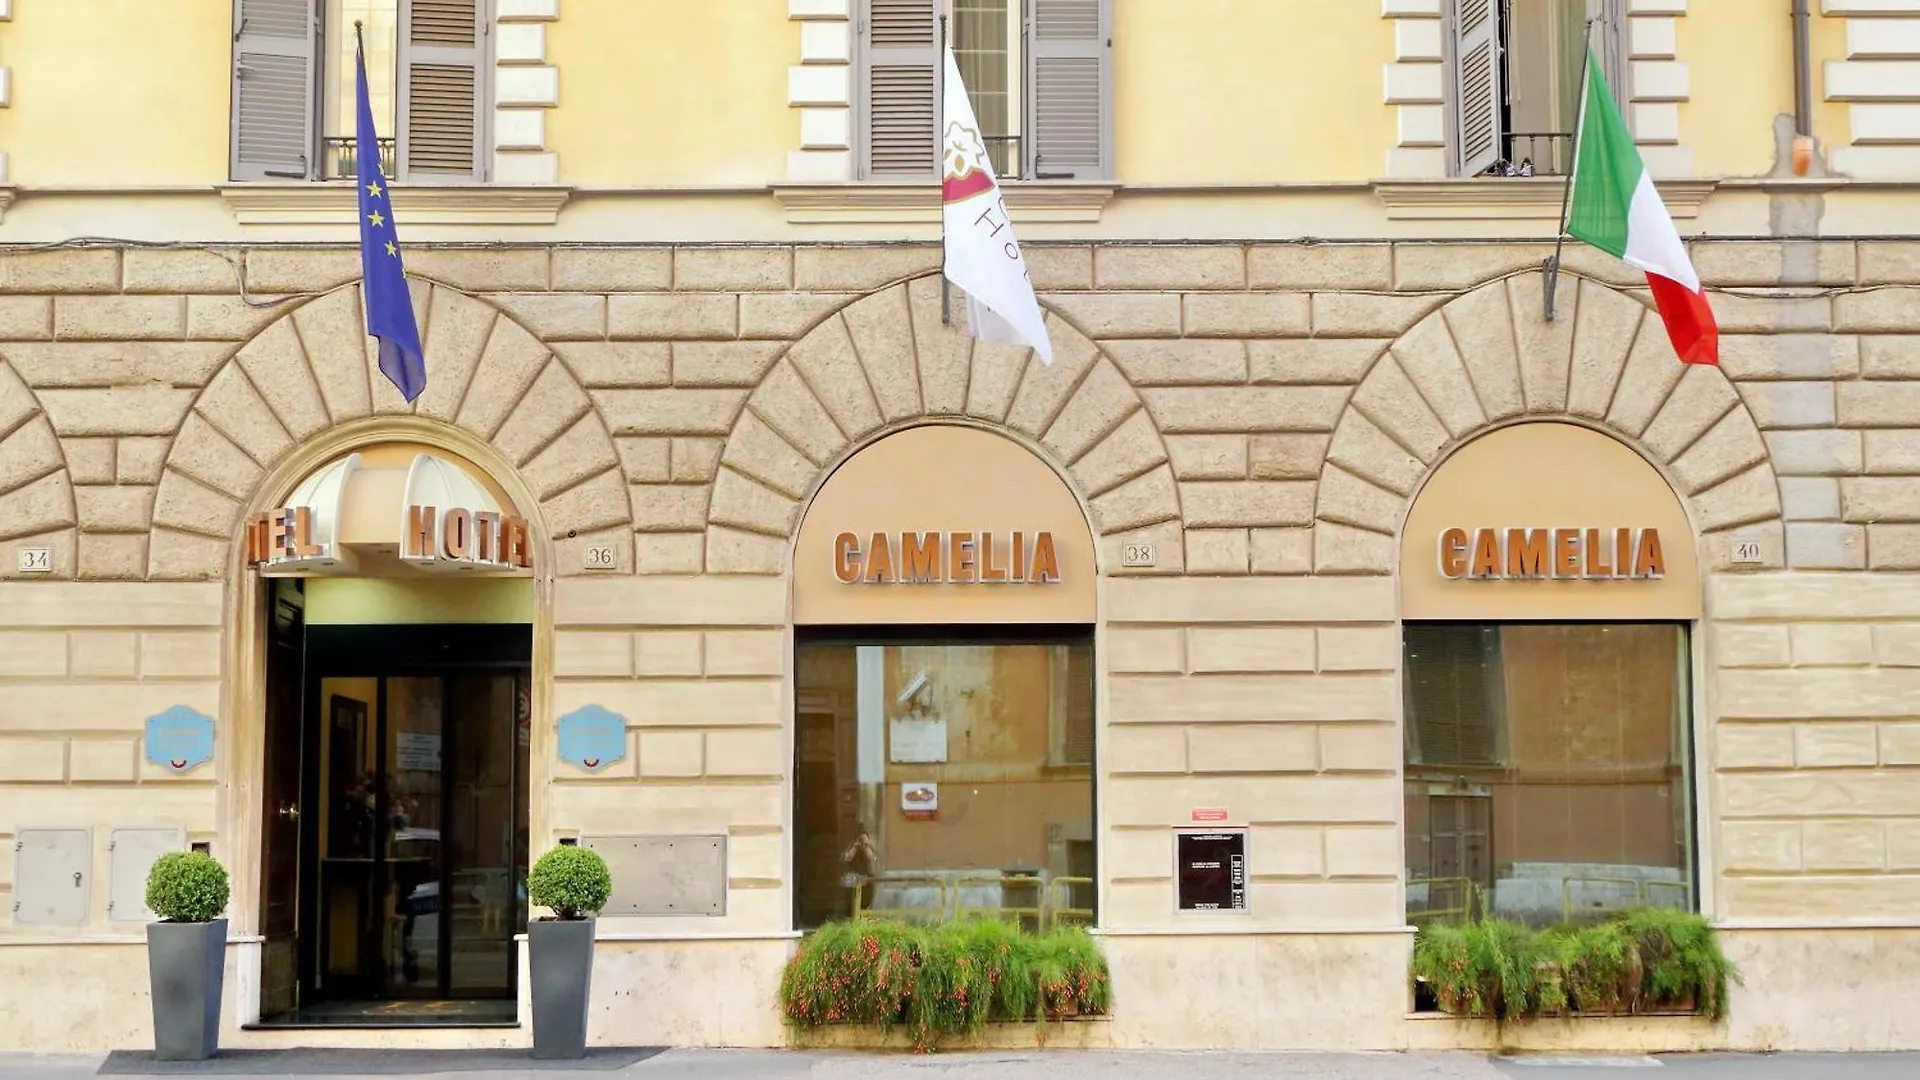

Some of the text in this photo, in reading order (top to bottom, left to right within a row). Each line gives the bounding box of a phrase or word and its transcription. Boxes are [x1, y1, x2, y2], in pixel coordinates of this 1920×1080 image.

[247, 506, 324, 565] TEL
[589, 548, 612, 564] 36
[833, 530, 1061, 583] CAMELIA
[1128, 545, 1150, 562] 38
[1437, 526, 1666, 580] CAMELIA
[1737, 543, 1759, 558] 40
[23, 551, 47, 568] 34
